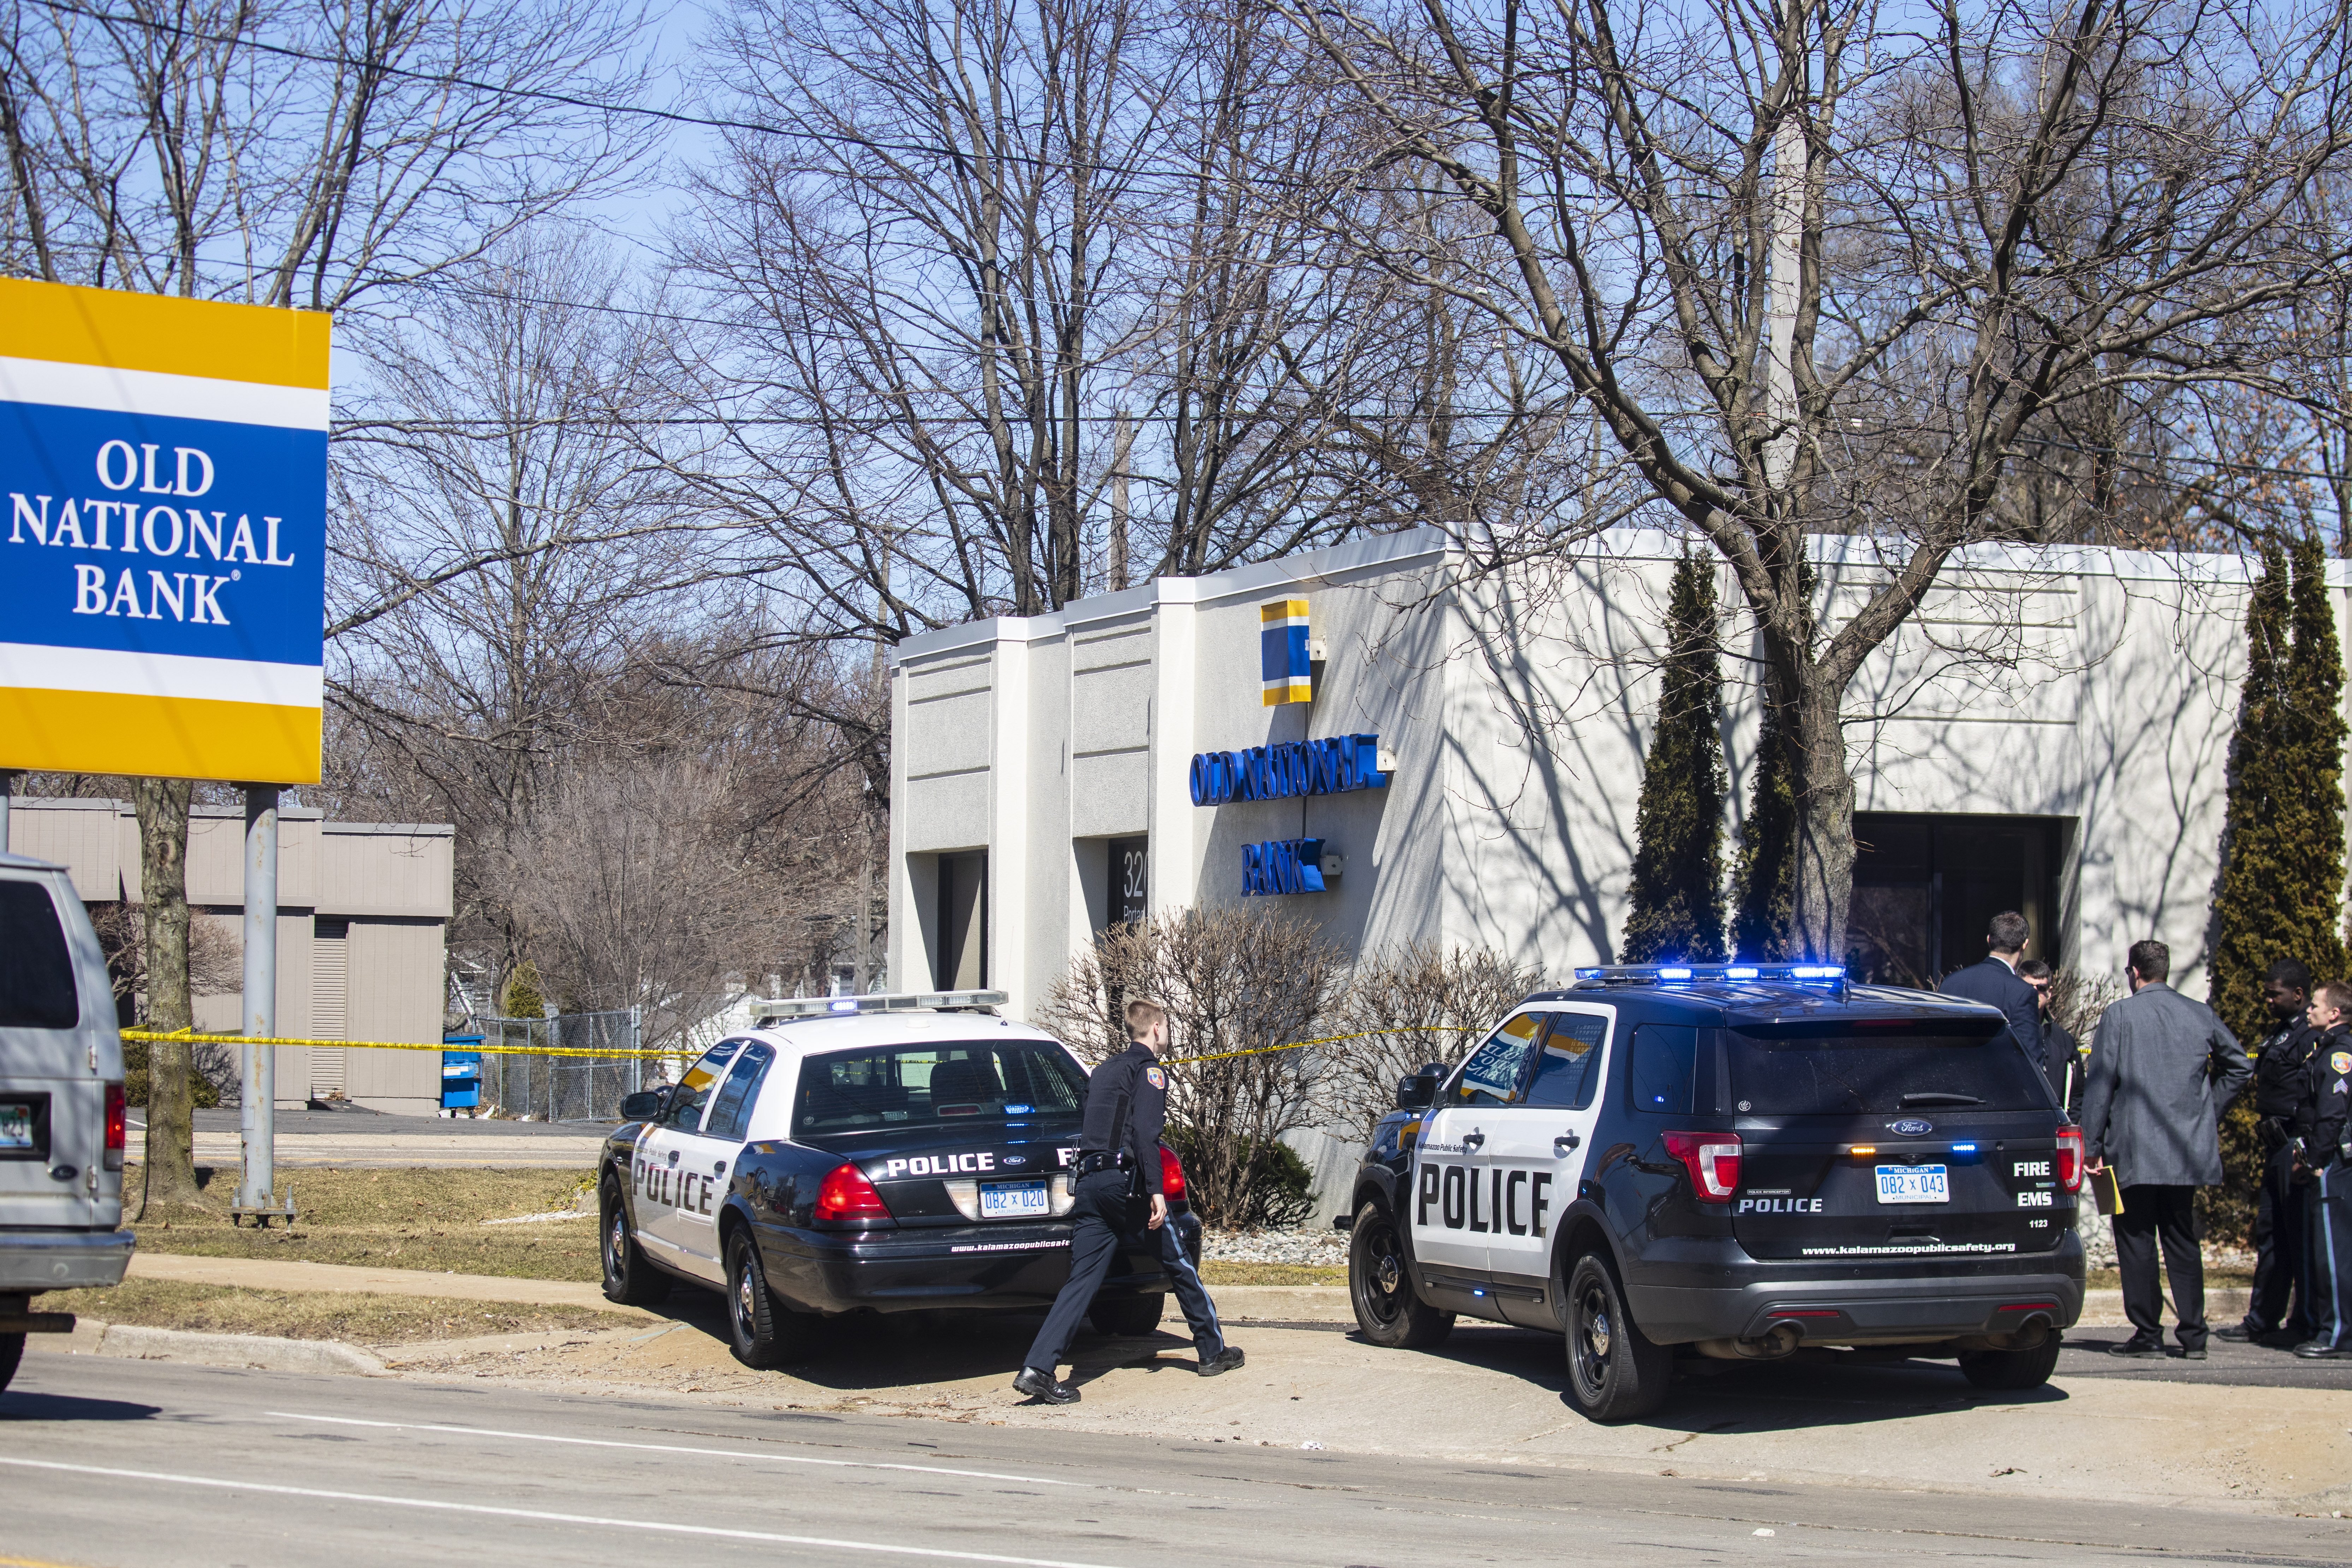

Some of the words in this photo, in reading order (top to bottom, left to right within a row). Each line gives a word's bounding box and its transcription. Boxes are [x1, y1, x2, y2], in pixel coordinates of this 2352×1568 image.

[96, 440, 214, 497] OLD
[9, 493, 295, 566] NATIONAL
[1189, 751, 1241, 806] OLD
[1242, 733, 1386, 801] NATIONAL
[1241, 838, 1325, 897] BANK
[1901, 1122, 1923, 1132] Ford
[1418, 1141, 1439, 1151] Kalamazoo
[1440, 1144, 1453, 1152] Public
[1453, 1145, 1467, 1156] Safety
[887, 1152, 995, 1177] POLICE
[2014, 1161, 2050, 1176] FIRE
[633, 1157, 715, 1217] POLICE
[1881, 1176, 1905, 1194] 082
[1921, 1175, 1944, 1193] 043
[985, 1192, 1007, 1209] 082
[1022, 1190, 1044, 1207] 020
[1417, 1163, 1552, 1238] POLICE
[1739, 1198, 1822, 1213] POLICE
[2018, 1191, 2052, 1207] EMS
[2029, 1219, 2048, 1228] 1123
[951, 1240, 1073, 1252] www.kalamazoopublicsafe
[1802, 1243, 2015, 1255] www.kalamazoopublicsafety.org
